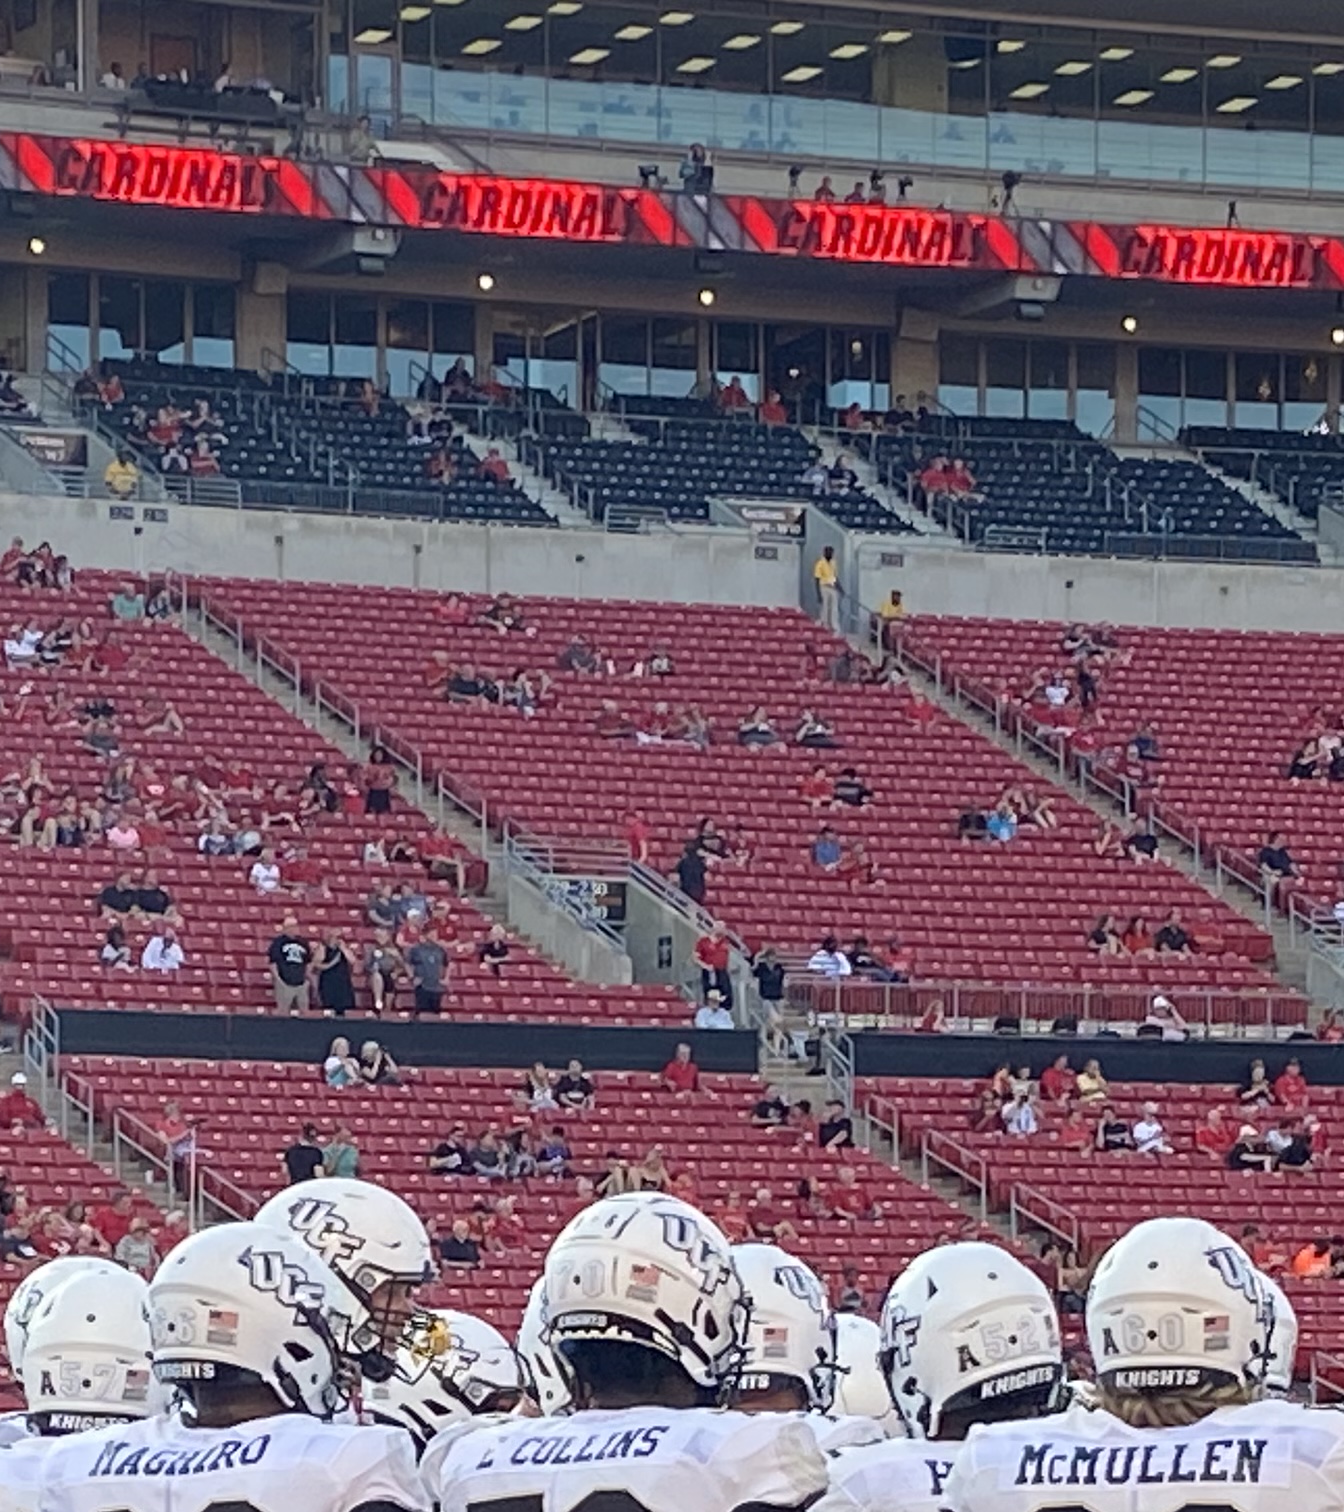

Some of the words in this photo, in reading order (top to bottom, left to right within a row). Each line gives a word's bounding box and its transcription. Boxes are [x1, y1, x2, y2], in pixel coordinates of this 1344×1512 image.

[288, 1198, 366, 1270] UCF
[1122, 1313, 1185, 1353] 60
[59, 1361, 117, 1400] 57
[980, 1365, 1055, 1400] KNIGHTS
[1115, 1369, 1201, 1388] KNIGHTS
[509, 1425, 671, 1466] COLLINS
[1013, 1439, 1269, 1486] McMULLEN
